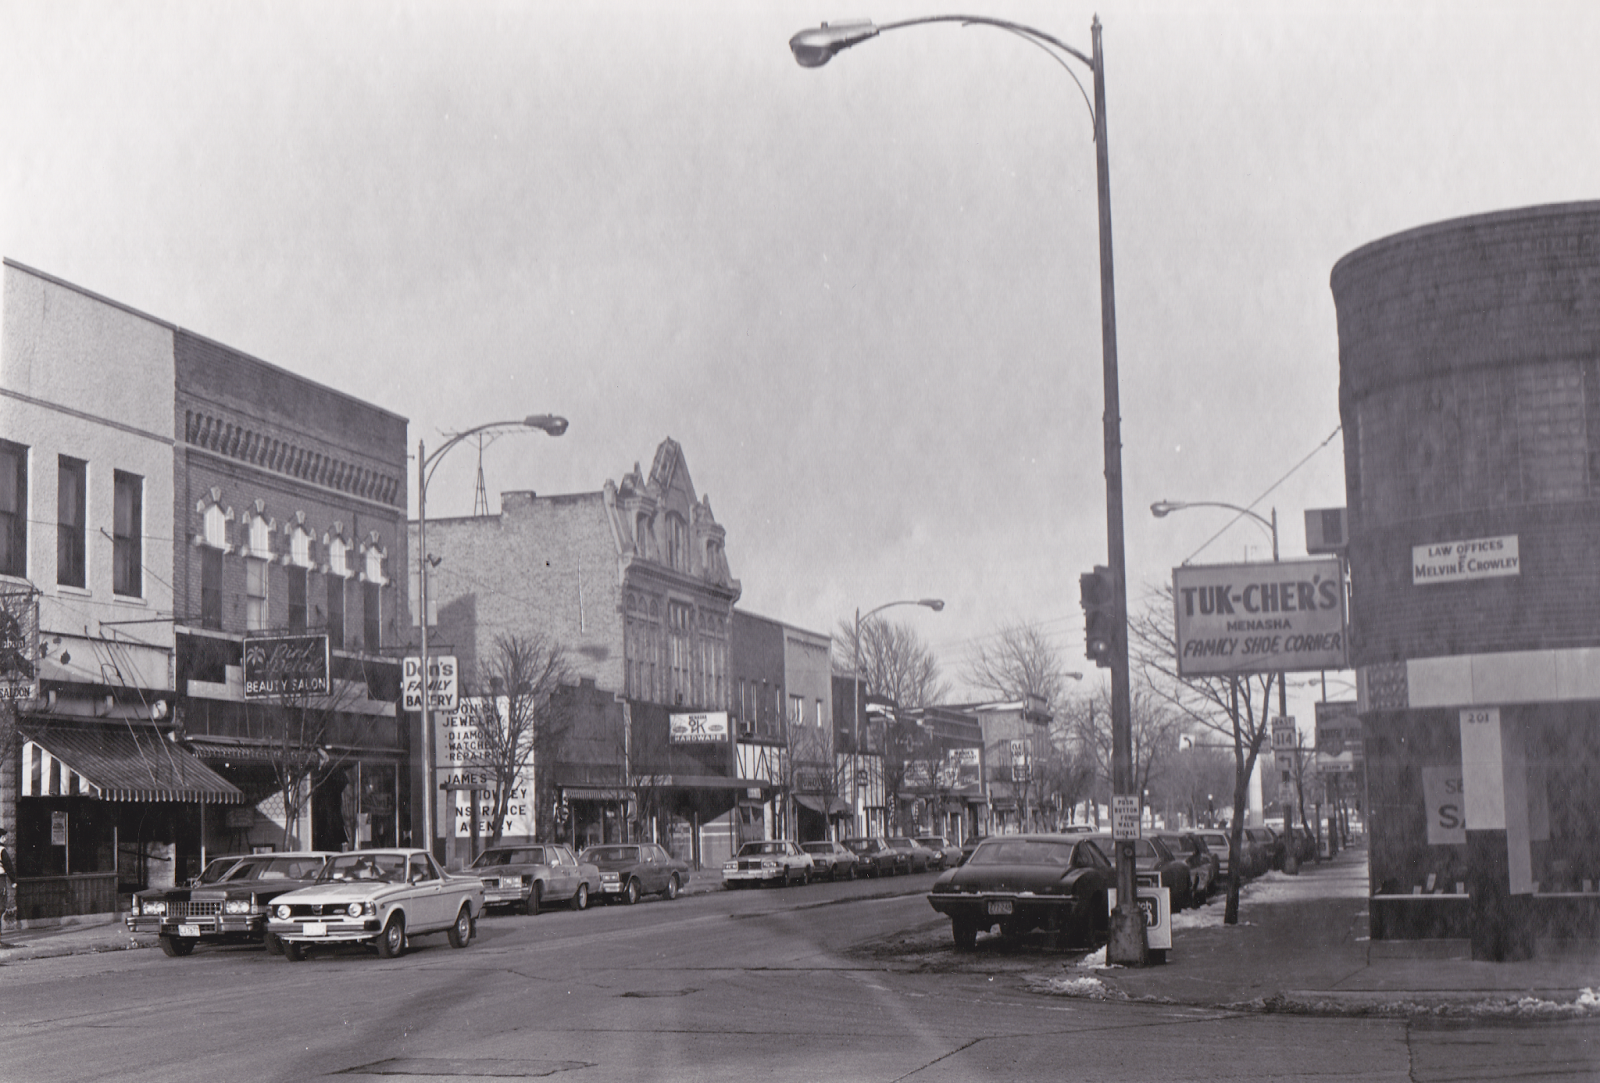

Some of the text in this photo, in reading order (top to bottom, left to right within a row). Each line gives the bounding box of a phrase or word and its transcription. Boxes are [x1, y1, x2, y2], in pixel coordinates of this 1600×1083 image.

[1428, 540, 1504, 558] LAW OFFICES
[1180, 574, 1338, 617] TUK-CHER'S
[1226, 618, 1292, 632] MENASHA
[1183, 632, 1342, 658] FAMILY SHOE CORNER
[246, 677, 326, 693] BEAUTY SALON
[406, 694, 453, 707] BAERY
[1468, 712, 1490, 725] 201
[1275, 732, 1293, 746] 114
[444, 773, 488, 785] JAMES
[460, 820, 513, 833] AENY
